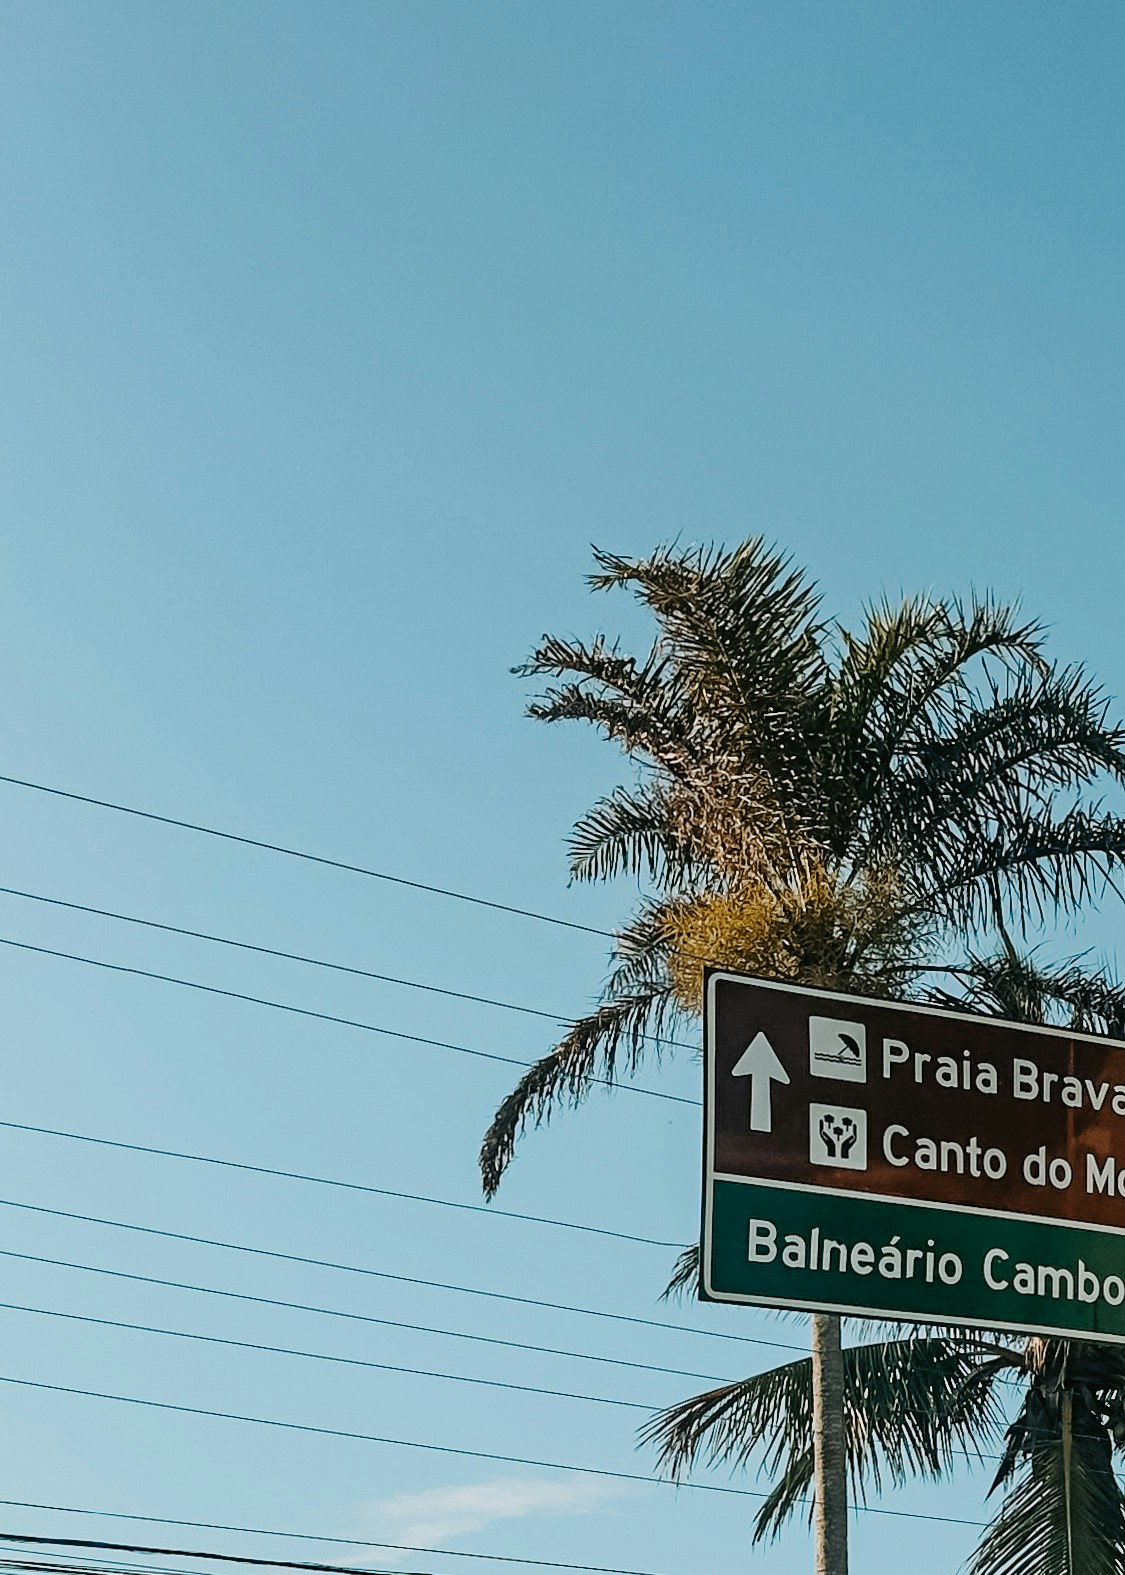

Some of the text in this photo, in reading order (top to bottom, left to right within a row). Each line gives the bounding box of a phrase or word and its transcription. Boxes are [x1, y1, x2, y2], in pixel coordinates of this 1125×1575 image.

[883, 1038, 998, 1094] Praia
[883, 1124, 1007, 1180] Canto
[1023, 1145, 1072, 1190] do
[748, 1218, 963, 1285] Balneário
